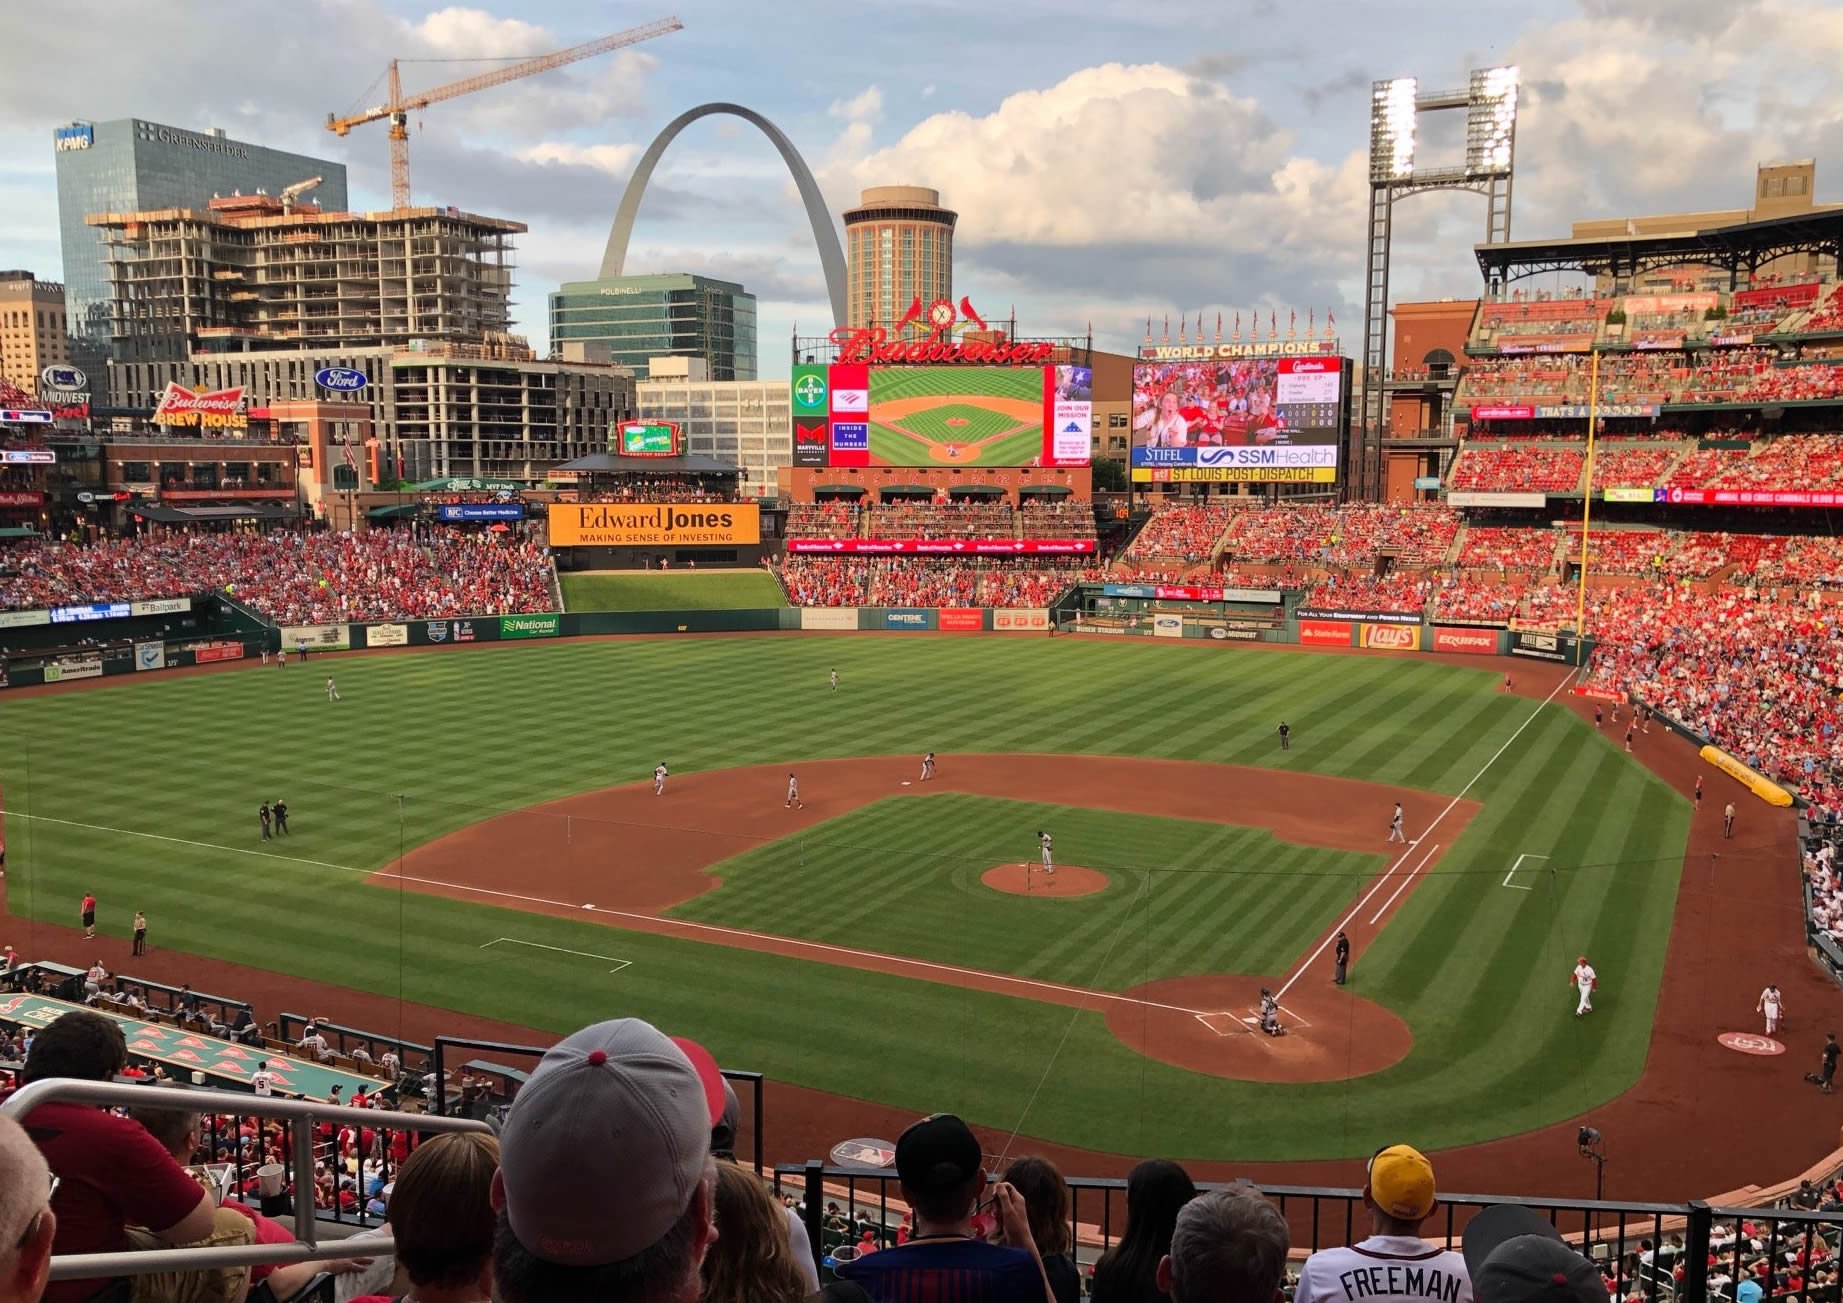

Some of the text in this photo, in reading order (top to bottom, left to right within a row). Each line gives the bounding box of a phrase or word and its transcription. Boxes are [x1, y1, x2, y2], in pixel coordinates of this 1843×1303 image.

[56, 135, 90, 151] KPMG
[158, 128, 249, 160] GREENSFELDER
[600, 287, 642, 297] POLSINELLI
[829, 327, 1056, 365] Budweiser
[1155, 342, 1321, 359] WORLD CHAMPIONS
[1292, 360, 1325, 373] Cardinals
[53, 370, 76, 381] FOX
[327, 369, 359, 387] Ford
[41, 390, 91, 404] MIDWEST
[1540, 406, 1574, 417] THAT'S
[1579, 406, 1586, 417] A
[157, 412, 248, 428] BREW HOUSE
[1145, 447, 1183, 461] STIFEL
[1238, 449, 1334, 465] SSMHealth
[873, 474, 880, 485] 9
[909, 474, 920, 485] 14
[928, 474, 940, 485] 17
[971, 474, 985, 485] 24
[995, 474, 1009, 485] 42
[1018, 474, 1032, 485] 45
[1041, 474, 1056, 485] 85
[1173, 467, 1314, 481] ST. LOUIS POST-DISPATCH
[1775, 493, 1811, 503] CARDINALS
[578, 507, 733, 531] Edward Jones
[579, 533, 733, 543] MAKING SENSE OF INVESTING
[150, 602, 182, 612] Ballpark
[515, 619, 555, 630] National
[1098, 627, 1124, 635] STADIUM
[1226, 631, 1257, 639] MIDWEST
[1314, 630, 1331, 638] State
[136, 642, 163, 651] CarShield
[1439, 635, 1491, 648] EQUIFAX
[61, 664, 101, 674] Ameritrade
[258, 1080, 265, 1089] 5
[1339, 1266, 1462, 1302] FREEMAN
